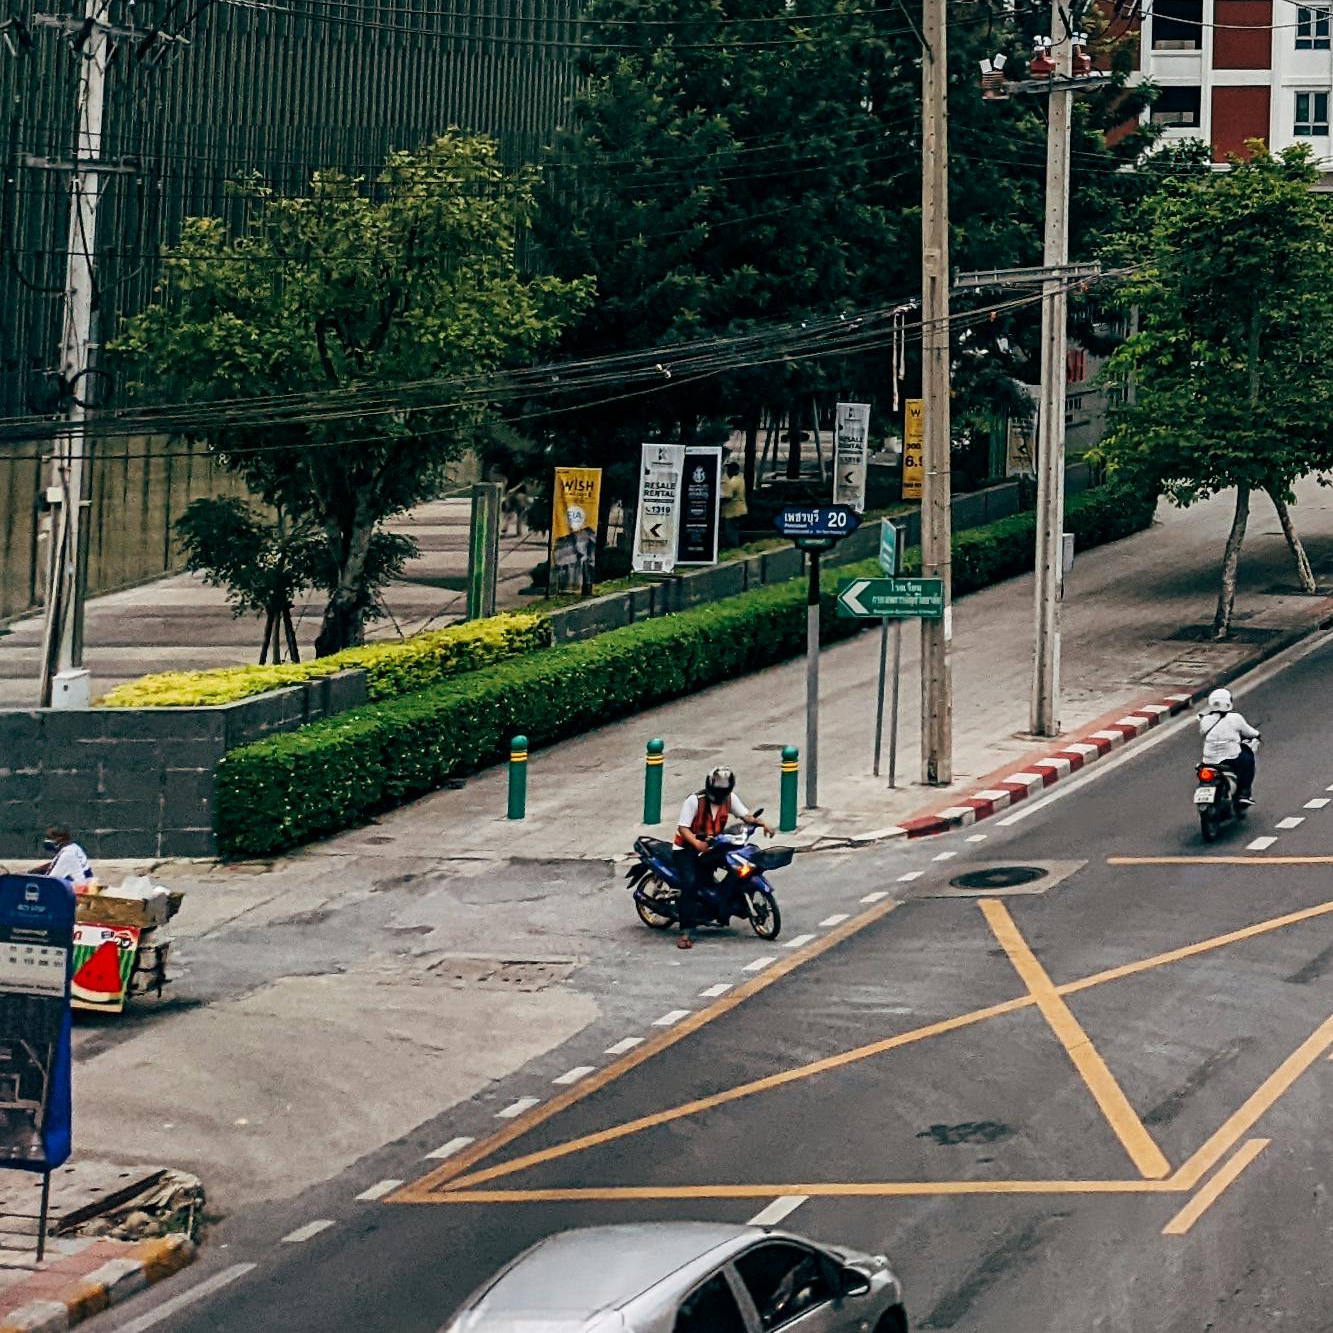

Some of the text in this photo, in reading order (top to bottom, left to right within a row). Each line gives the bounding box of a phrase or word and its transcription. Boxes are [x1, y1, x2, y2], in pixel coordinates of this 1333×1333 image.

[561, 477, 594, 492] WISH
[643, 489, 675, 497] RENTAL
[784, 509, 847, 528] เพชรบุรี 20
